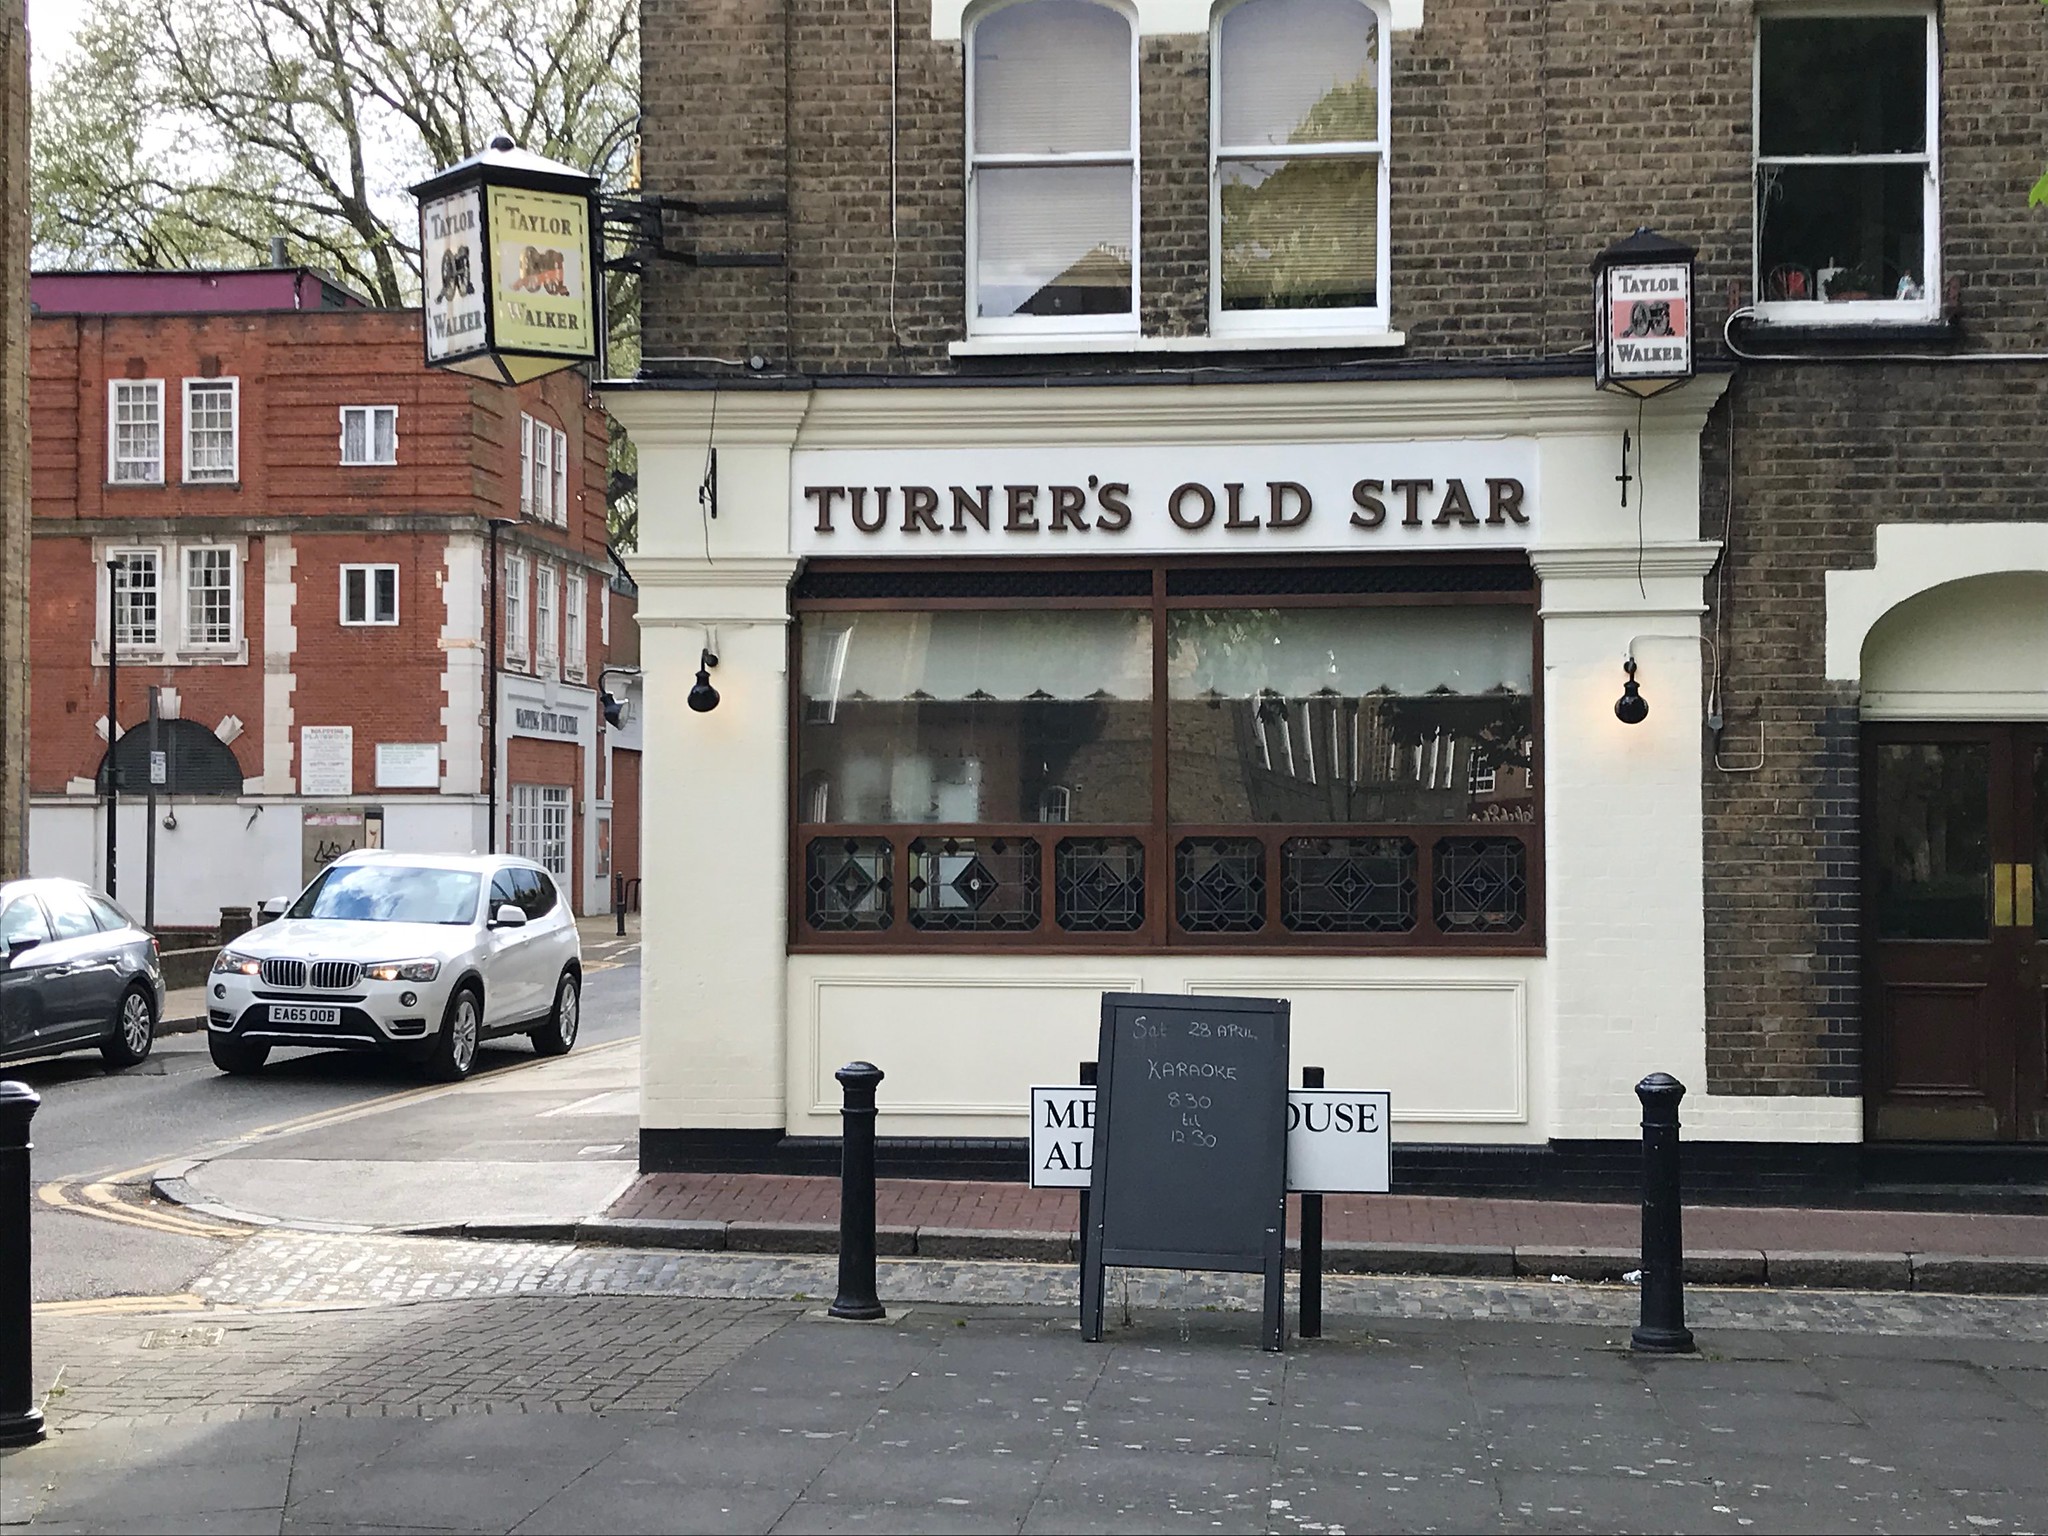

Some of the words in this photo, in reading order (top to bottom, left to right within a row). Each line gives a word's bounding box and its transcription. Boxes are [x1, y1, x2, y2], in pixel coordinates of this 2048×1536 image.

[431, 209, 475, 240] TAYLOR
[505, 206, 573, 236] TAYLOR
[1618, 274, 1680, 294] TAYLOR
[433, 310, 483, 340] WALKER
[507, 301, 580, 330] WALKER
[1616, 343, 1684, 363] WALKER
[804, 474, 1133, 533] TURNER'S
[1167, 481, 1313, 530] OLD
[1349, 478, 1531, 528] STAR
[274, 1008, 306, 1022] EA65
[1133, 1016, 1167, 1039] Sat
[1188, 1021, 1211, 1038] 28
[1147, 1058, 1237, 1081] KARAOKE
